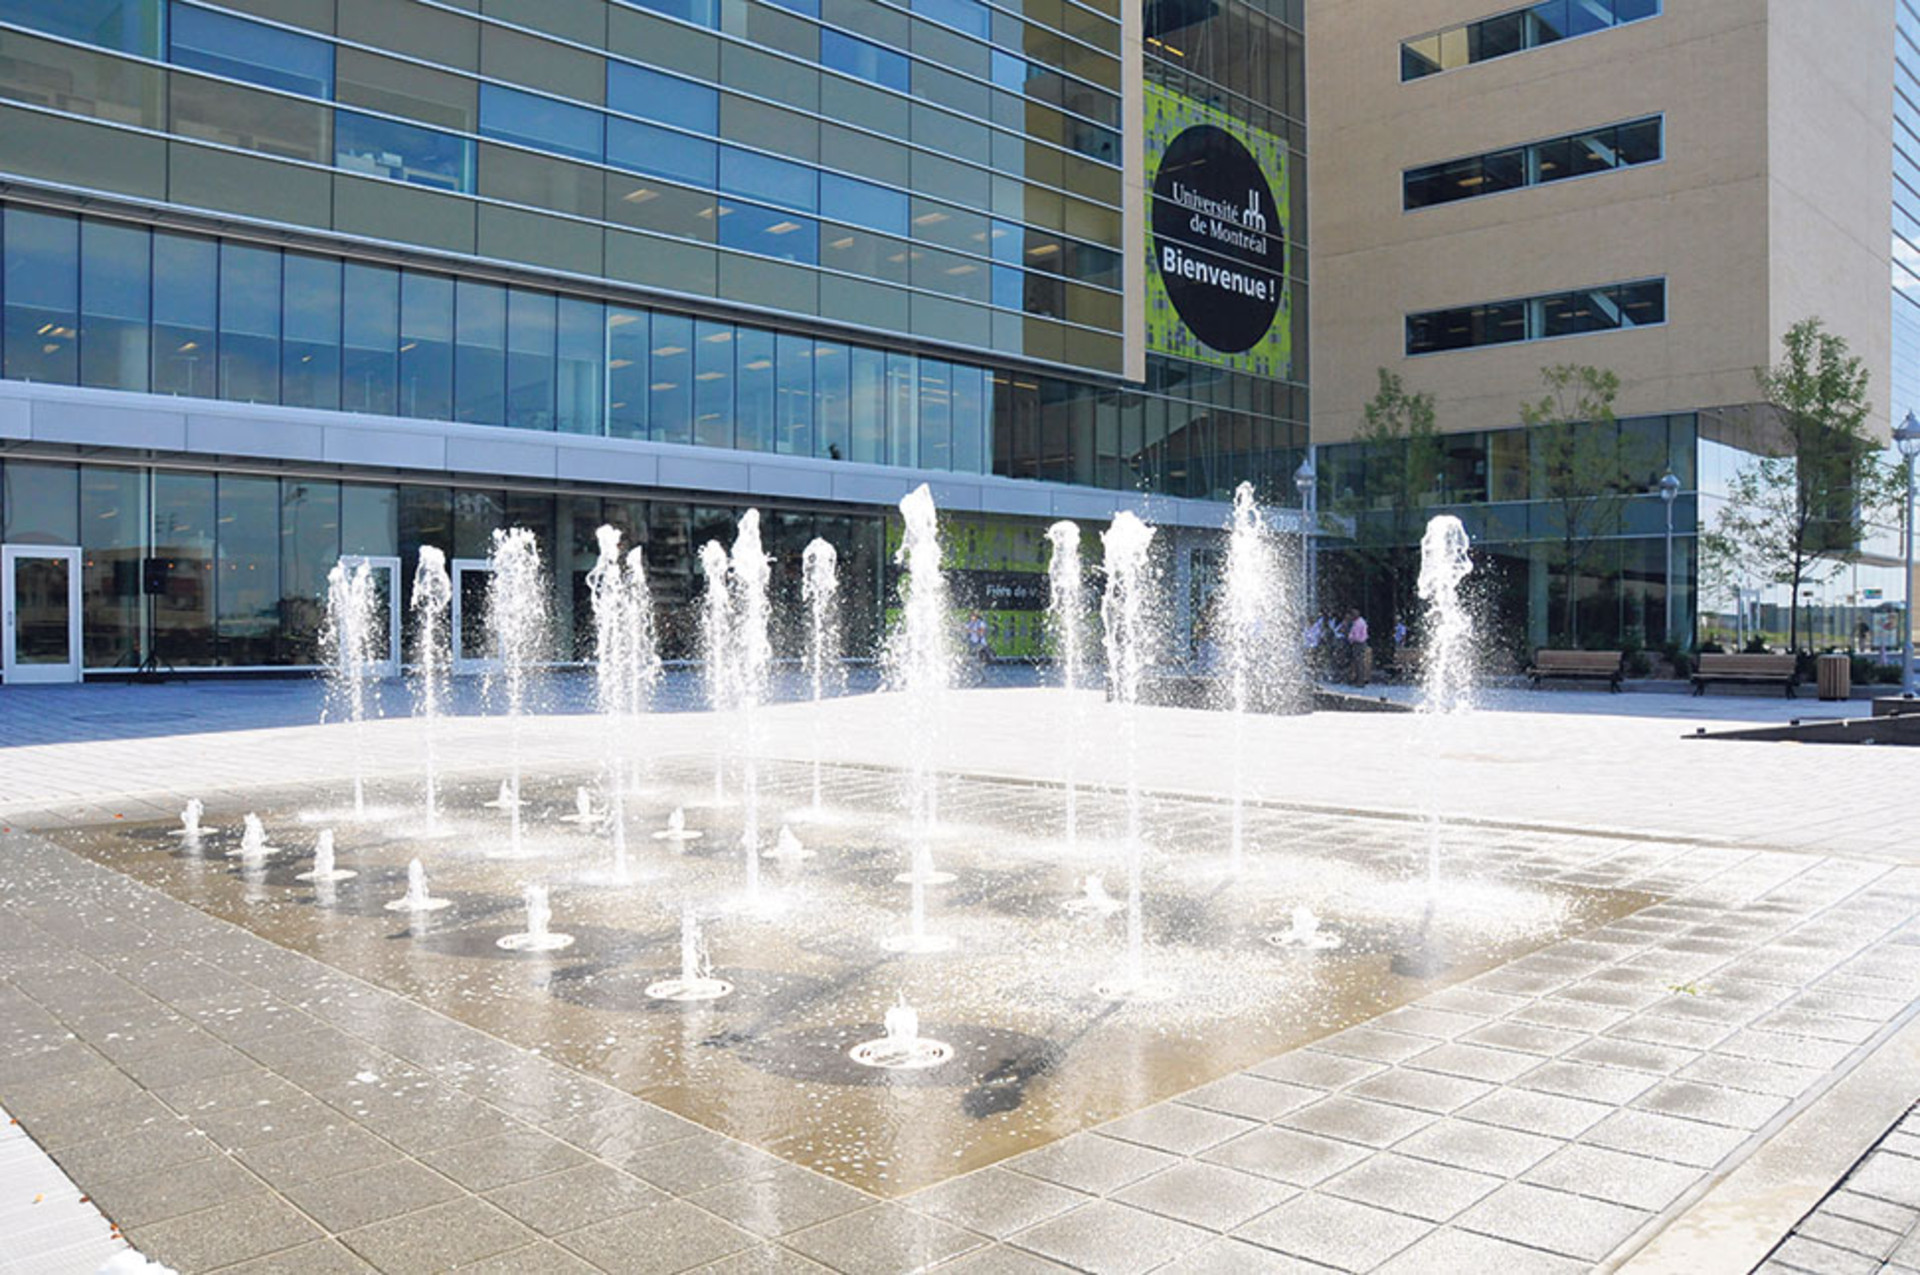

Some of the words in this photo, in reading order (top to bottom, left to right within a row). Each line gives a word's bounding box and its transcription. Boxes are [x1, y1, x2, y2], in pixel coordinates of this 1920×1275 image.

[1173, 182, 1239, 223] Université
[1189, 213, 1207, 235] de
[1210, 219, 1266, 254] Montréal
